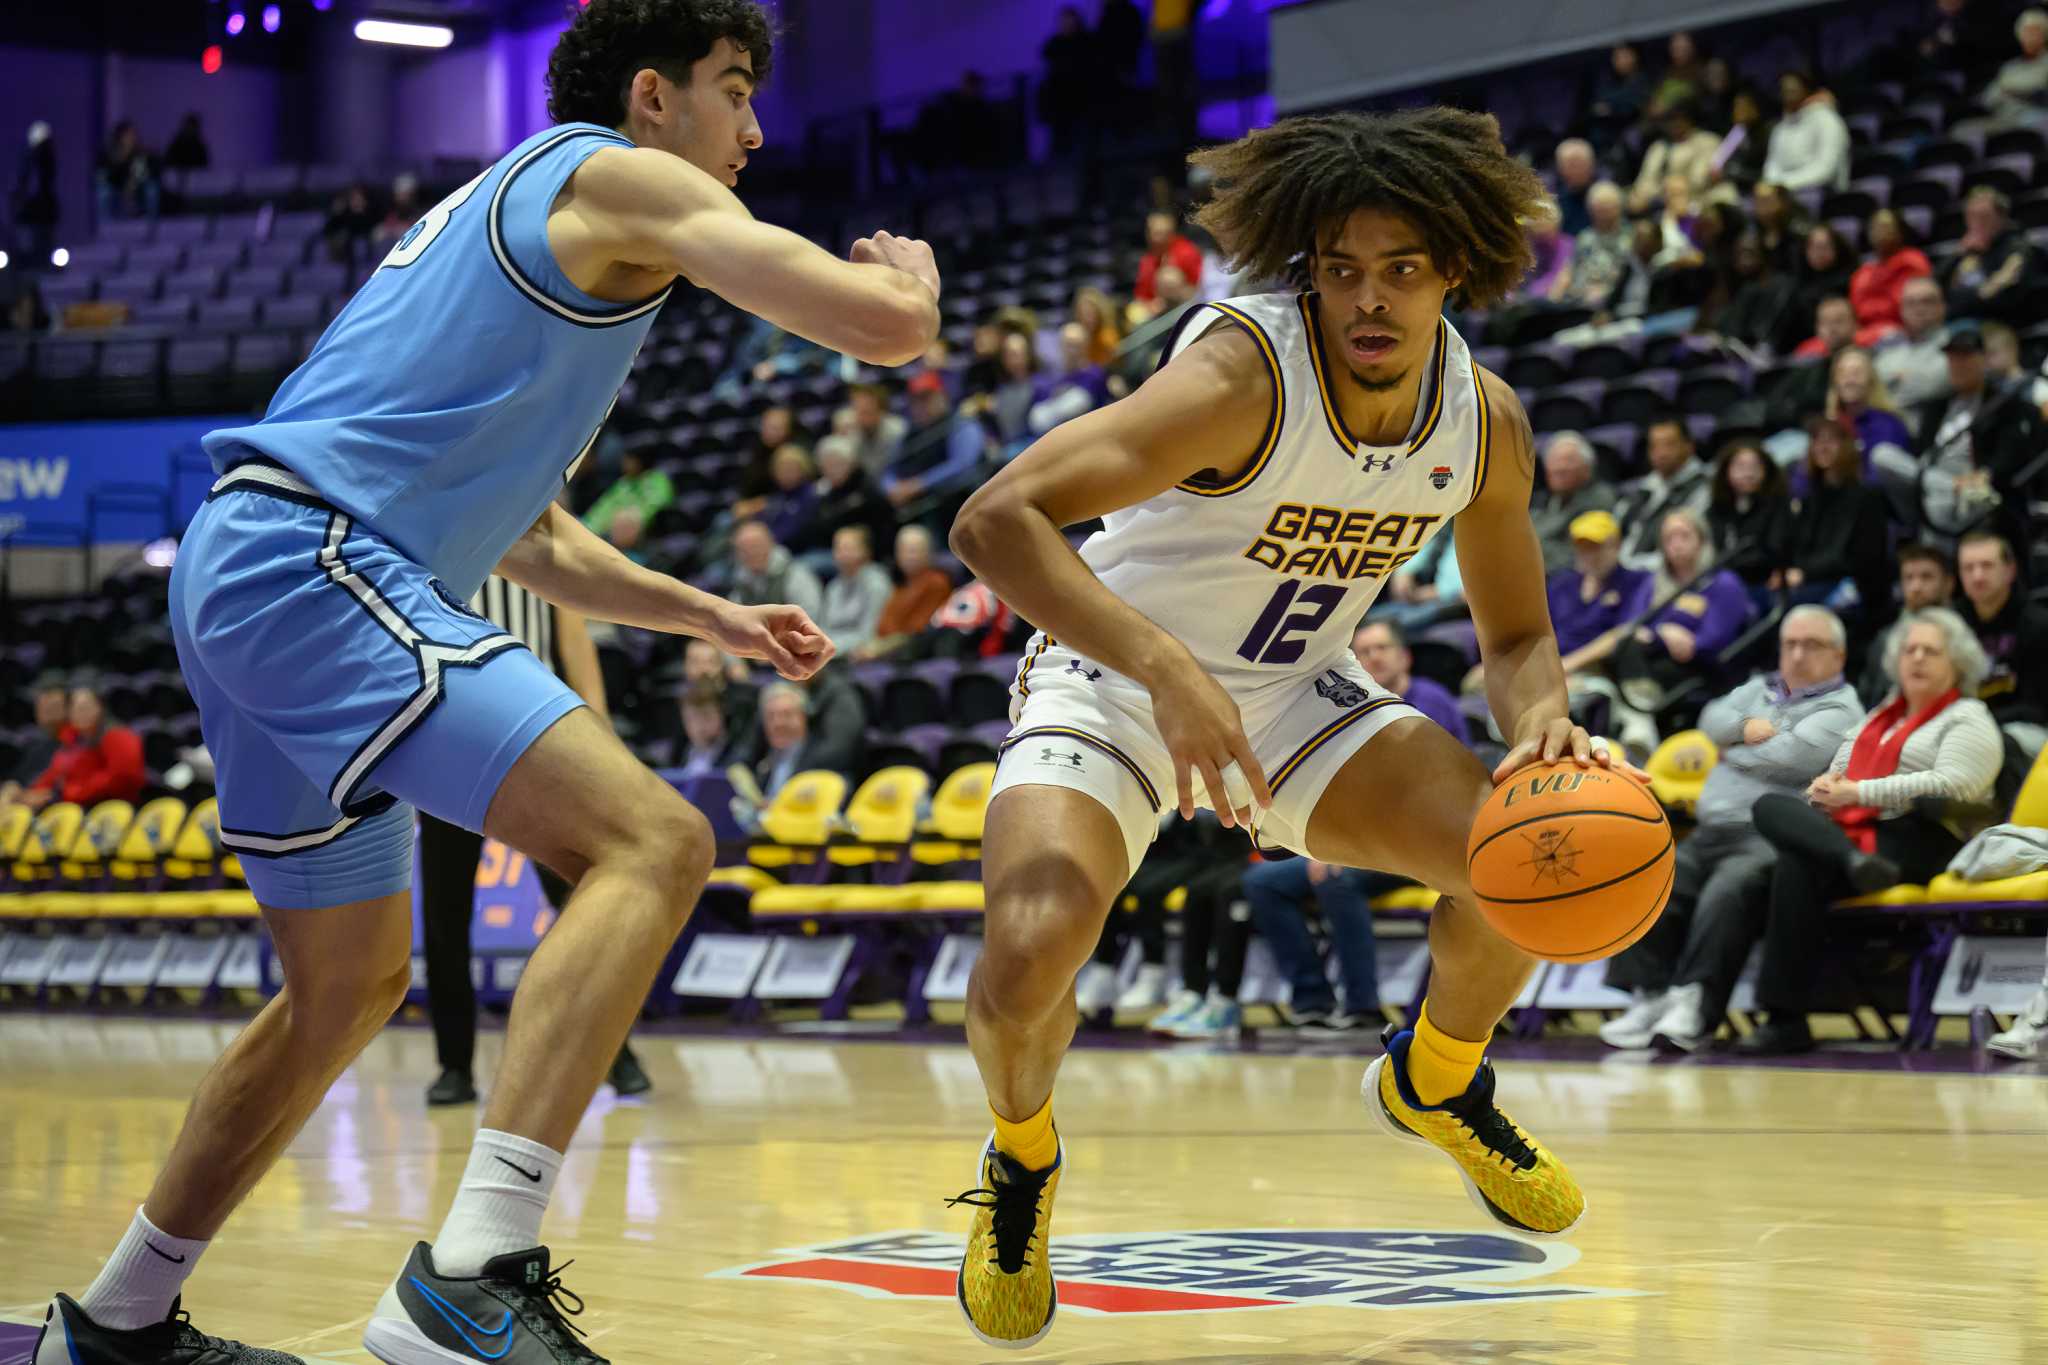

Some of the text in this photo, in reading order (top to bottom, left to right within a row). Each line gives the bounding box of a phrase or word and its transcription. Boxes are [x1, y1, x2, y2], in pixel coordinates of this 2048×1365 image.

[1265, 503, 1443, 547] GREAT
[1236, 578, 1349, 664] 12
[1504, 772, 1584, 808] EVO
[816, 1235, 1592, 1306] AMERCA
[1048, 1239, 1510, 1279] EAST
